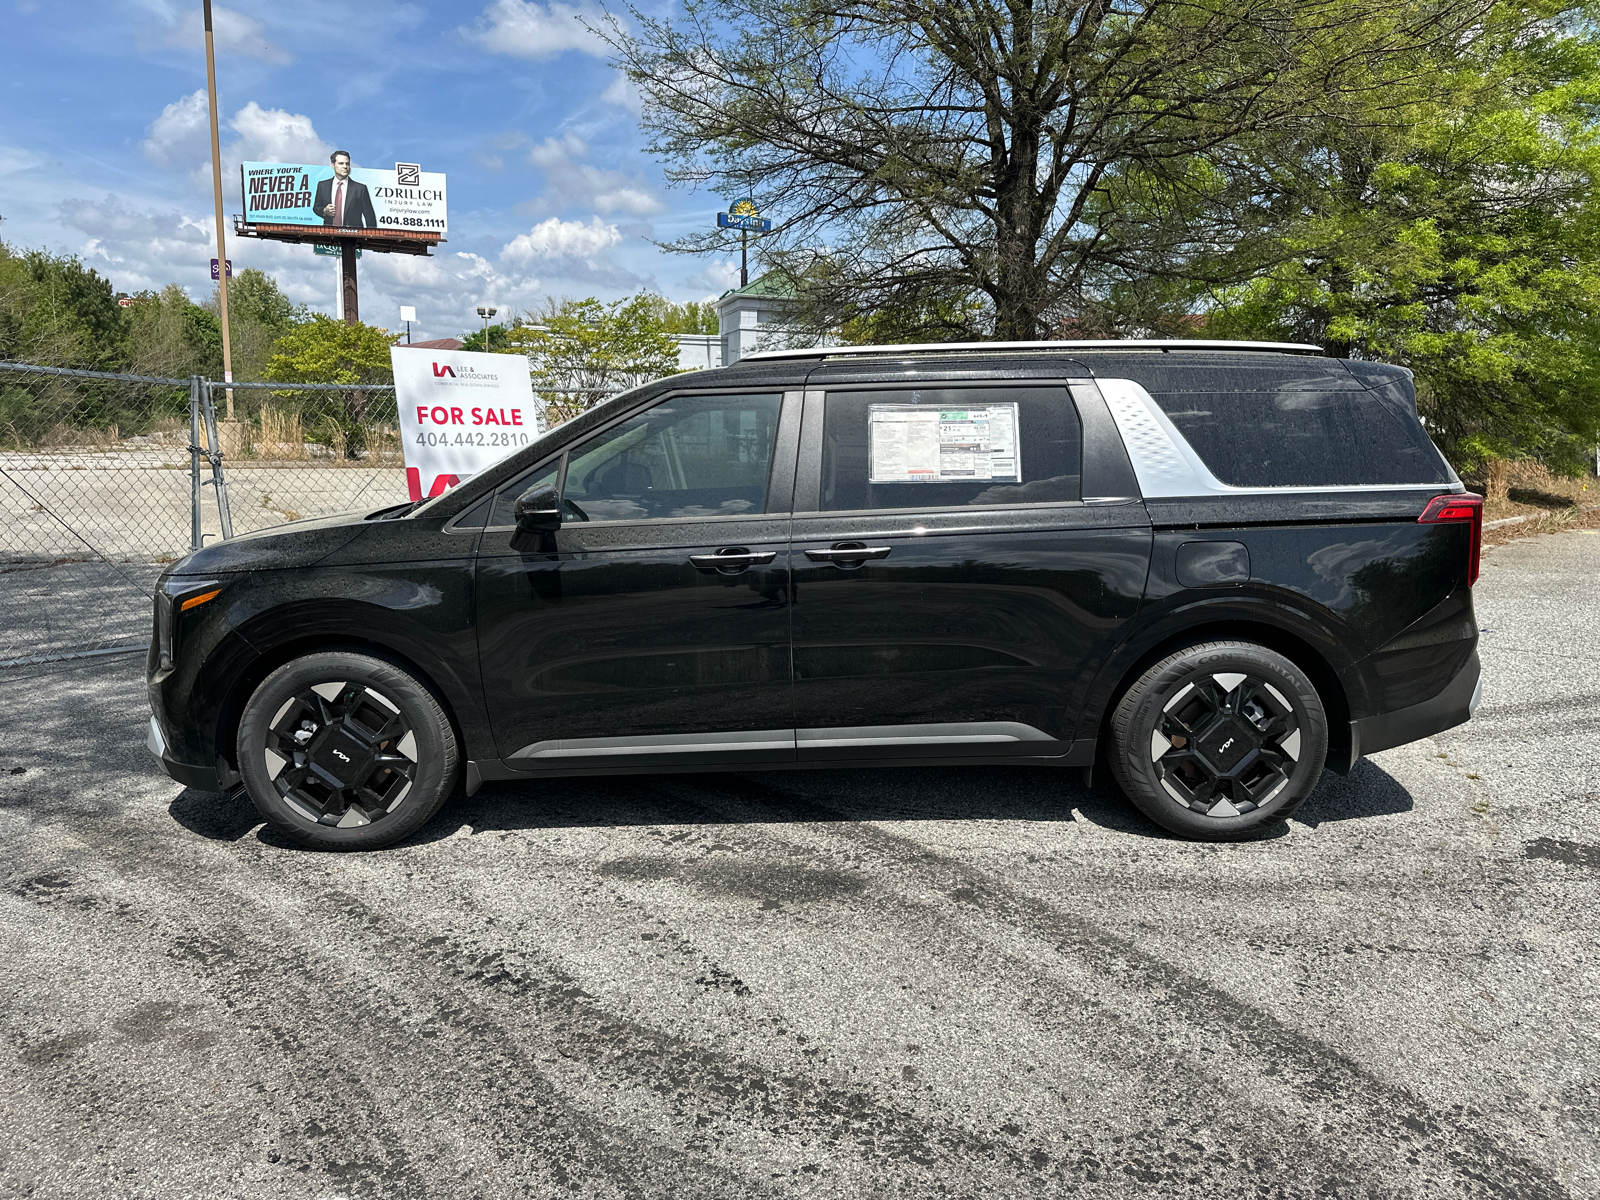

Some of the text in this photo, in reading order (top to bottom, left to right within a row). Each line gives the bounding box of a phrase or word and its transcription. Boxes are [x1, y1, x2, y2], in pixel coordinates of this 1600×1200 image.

[248, 168, 274, 176] WHERE
[249, 174, 309, 194] NEVER A
[375, 187, 442, 201] ZDRILICH
[249, 192, 312, 211] NUMBER
[379, 216, 445, 228] 404.888.1111
[460, 373, 498, 381] ASSOCIATES
[416, 406, 524, 426] FOR SALE
[416, 432, 529, 447] 404.442.2810
